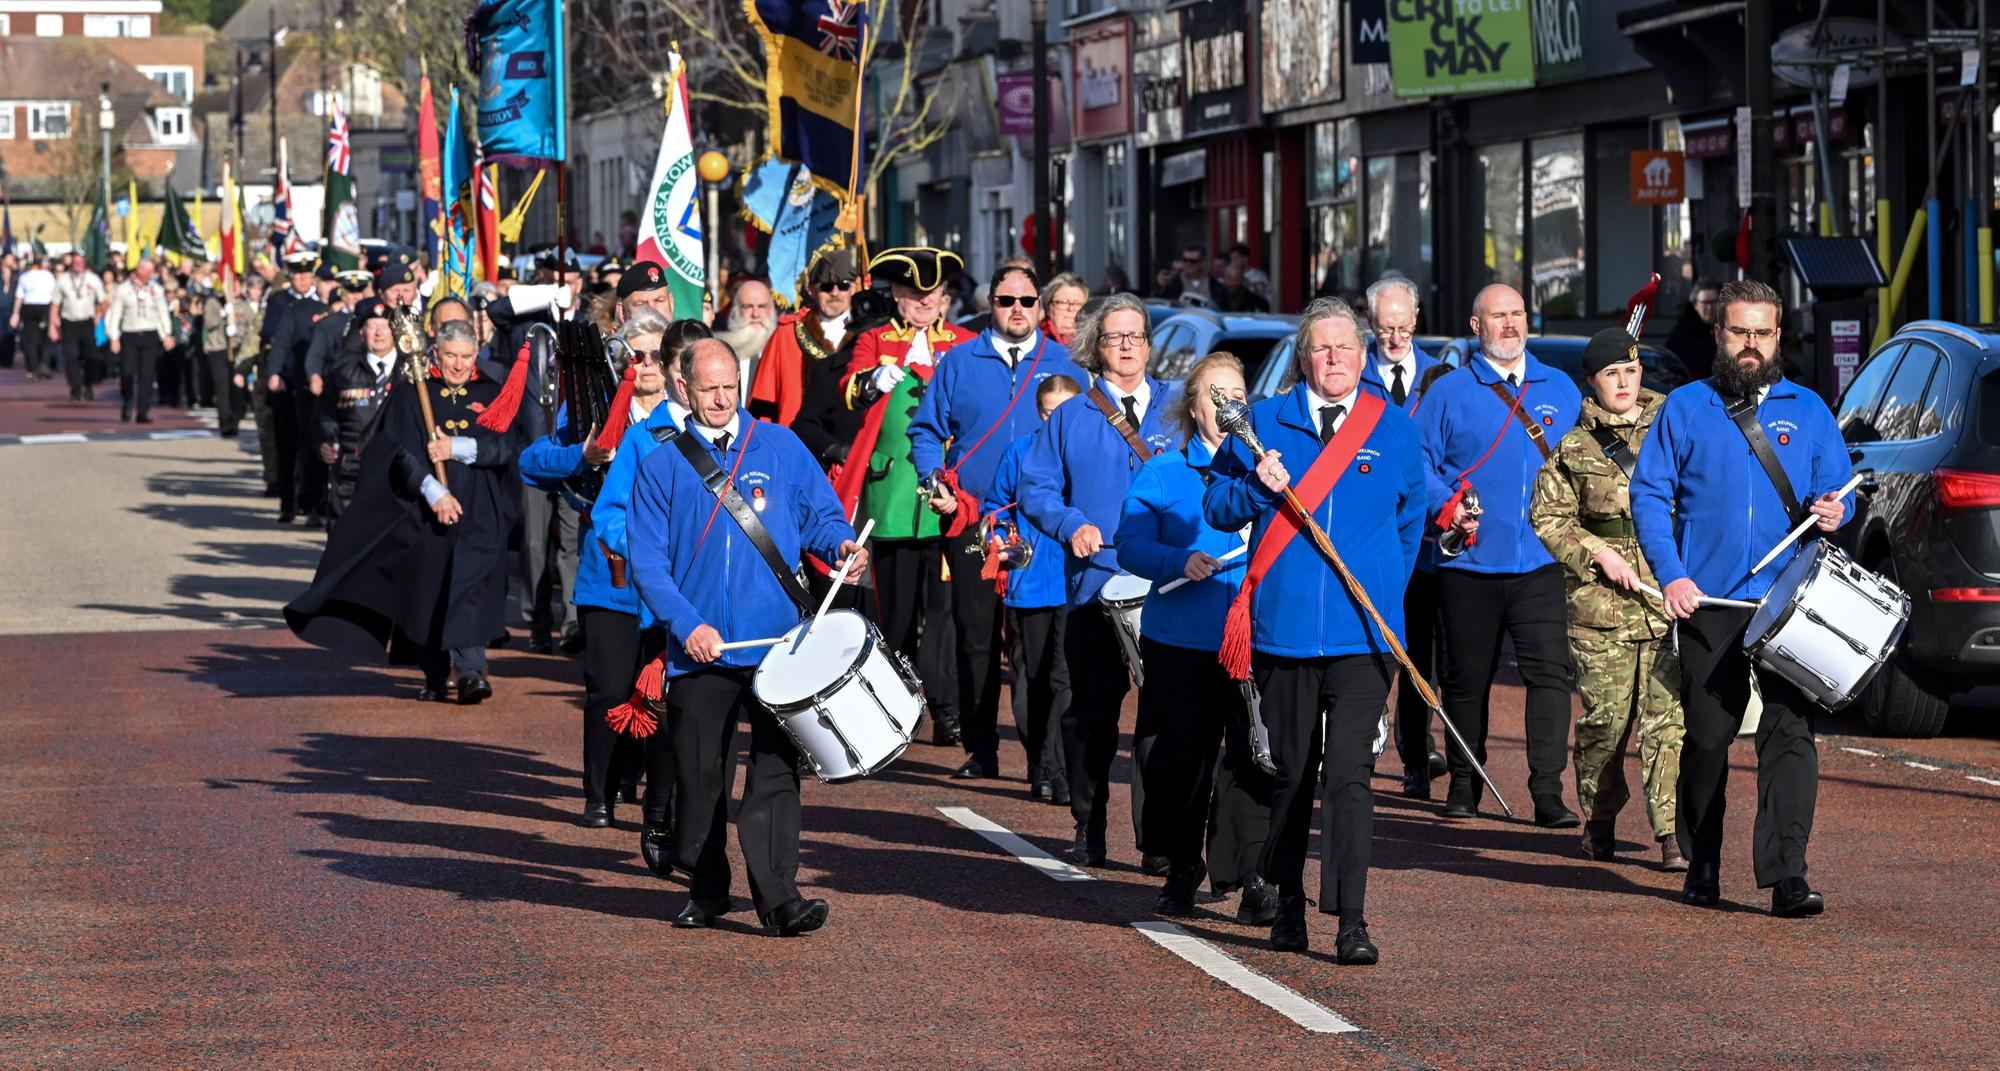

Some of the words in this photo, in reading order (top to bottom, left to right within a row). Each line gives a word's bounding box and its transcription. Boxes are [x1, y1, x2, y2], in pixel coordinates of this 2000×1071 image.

[1456, 0, 1482, 15] TO
[1490, 0, 1522, 12] LET
[1360, 18, 1389, 43] M
[1424, 42, 1510, 78] MAY
